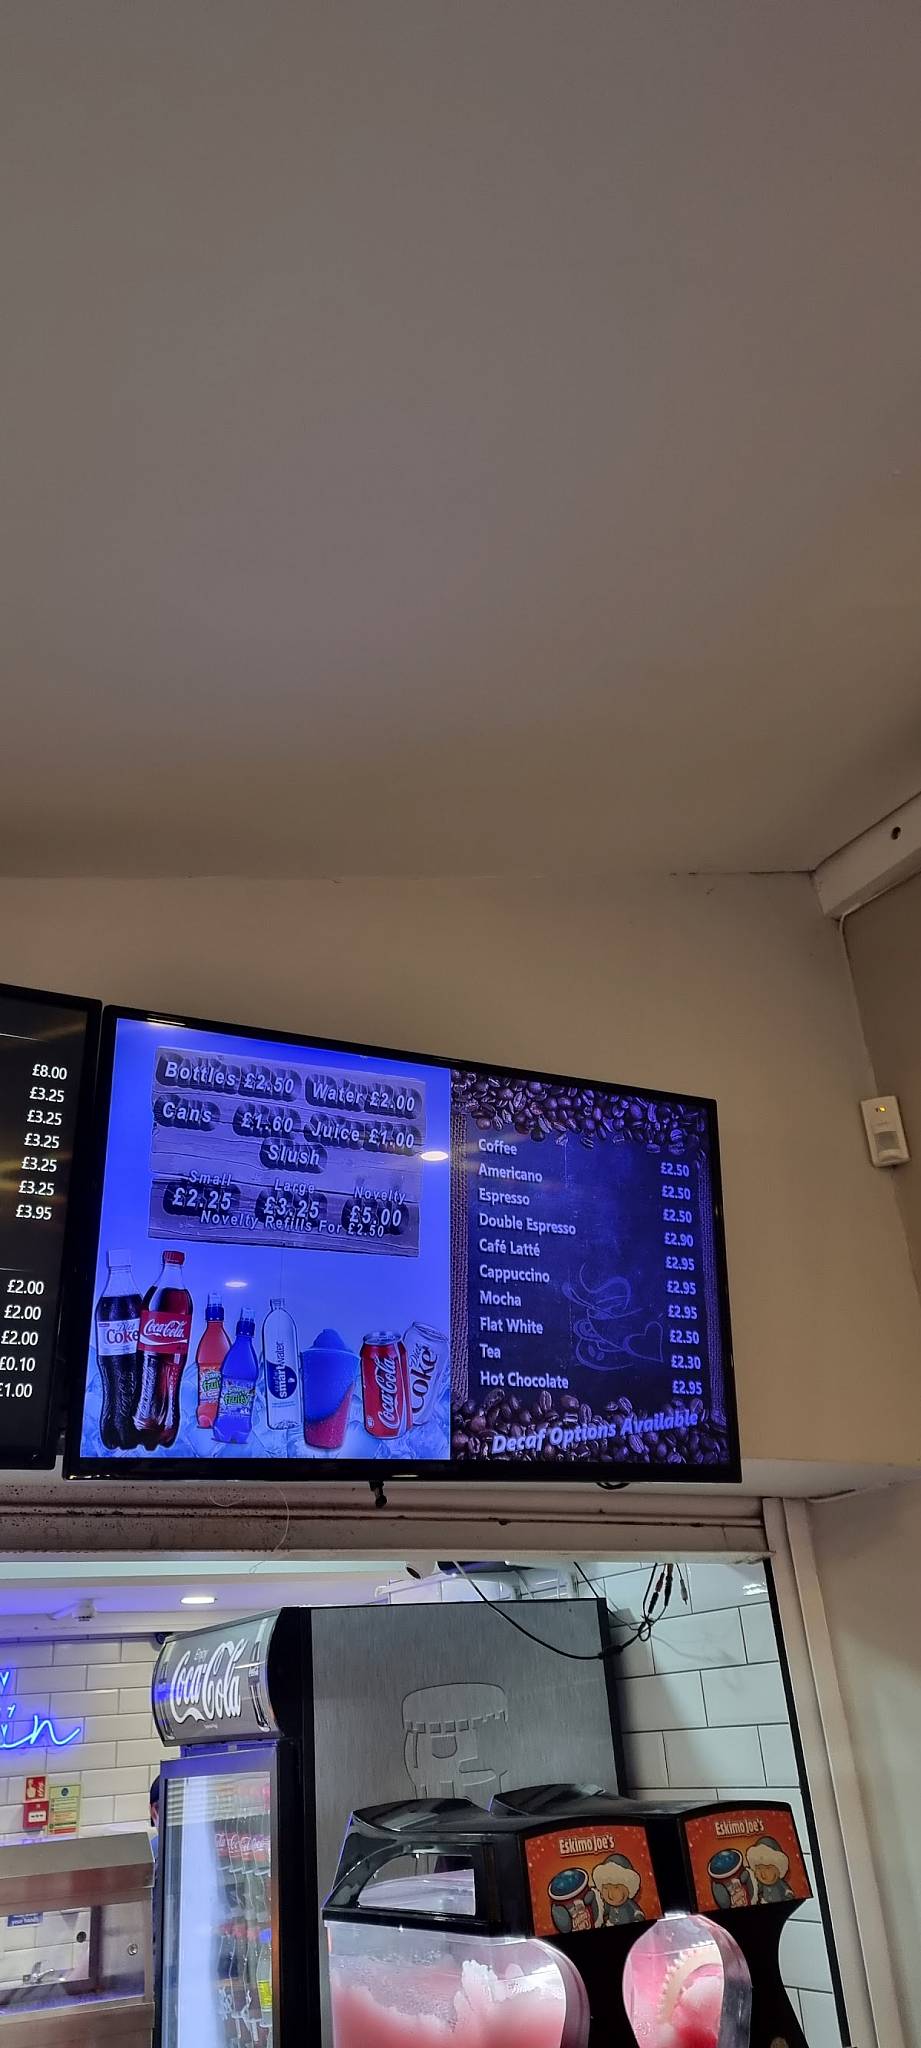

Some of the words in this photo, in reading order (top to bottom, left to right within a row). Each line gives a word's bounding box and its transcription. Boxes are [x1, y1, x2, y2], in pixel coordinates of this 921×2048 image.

[32, 1064, 67, 1079] £8.00
[30, 1087, 64, 1102] £3.25
[164, 1061, 236, 1086] Bottles
[244, 1073, 294, 1094] £2.50
[312, 1082, 362, 1105] Water
[370, 1091, 414, 1112] £2.00
[27, 1110, 62, 1125] £3.25
[162, 1101, 212, 1123] Cans
[241, 1111, 294, 1133] £1.60
[312, 1122, 360, 1142] Juice
[369, 1128, 414, 1149] £1.00
[24, 1133, 60, 1148] £3.25
[22, 1157, 57, 1172] £3.25
[268, 1145, 320, 1166] Slush
[478, 1138, 518, 1156] Coffee
[660, 1162, 690, 1178] £2.50
[18, 1180, 54, 1196] £3.25
[188, 1170, 232, 1186] Small
[274, 1178, 315, 1196] Large
[354, 1186, 406, 1205] Novelty
[478, 1162, 542, 1183] Americano
[662, 1185, 690, 1200] £2.50
[16, 1205, 52, 1220] £3.95
[172, 1188, 232, 1211] £2.25
[264, 1196, 320, 1218] £3.25
[350, 1205, 402, 1228] £5.00
[478, 1188, 530, 1206] Espresso
[663, 1208, 692, 1224] £2.50
[200, 1210, 258, 1230] Novelty
[265, 1215, 312, 1232] Refills
[318, 1220, 342, 1234] For
[348, 1224, 384, 1238] £2.50
[479, 1213, 523, 1231] Double
[526, 1217, 576, 1236] Espresso
[664, 1232, 694, 1248] £2.90
[479, 1238, 506, 1254] Café
[510, 1240, 541, 1256] Latté
[665, 1256, 695, 1272] £2.95
[7, 1280, 44, 1295] £2.00
[480, 1264, 550, 1283] Cappuccino
[666, 1280, 696, 1296] £2.95
[4, 1305, 41, 1320] £2.00
[480, 1290, 522, 1307] Mocha
[668, 1304, 698, 1320] £2.95
[1, 1330, 38, 1346] £2.00
[106, 1328, 140, 1344] Coke
[480, 1316, 504, 1332] Flat
[506, 1318, 544, 1335] White
[669, 1330, 699, 1345] £2.50
[0, 1356, 35, 1371] £0.10
[480, 1343, 500, 1360] Tea
[671, 1355, 700, 1370] £2.30
[412, 1346, 438, 1414] Coke
[480, 1371, 504, 1388] Hot
[508, 1372, 569, 1390] Chocolate
[672, 1380, 702, 1396] £2.95
[492, 1428, 546, 1454] Decaf
[550, 1423, 616, 1446] Options
[620, 1409, 698, 1436] Available
[715, 1820, 746, 1837] Eskimo
[745, 1818, 764, 1834] Joe's
[558, 1837, 592, 1855] Eskimo
[592, 1834, 615, 1854] Joe's
